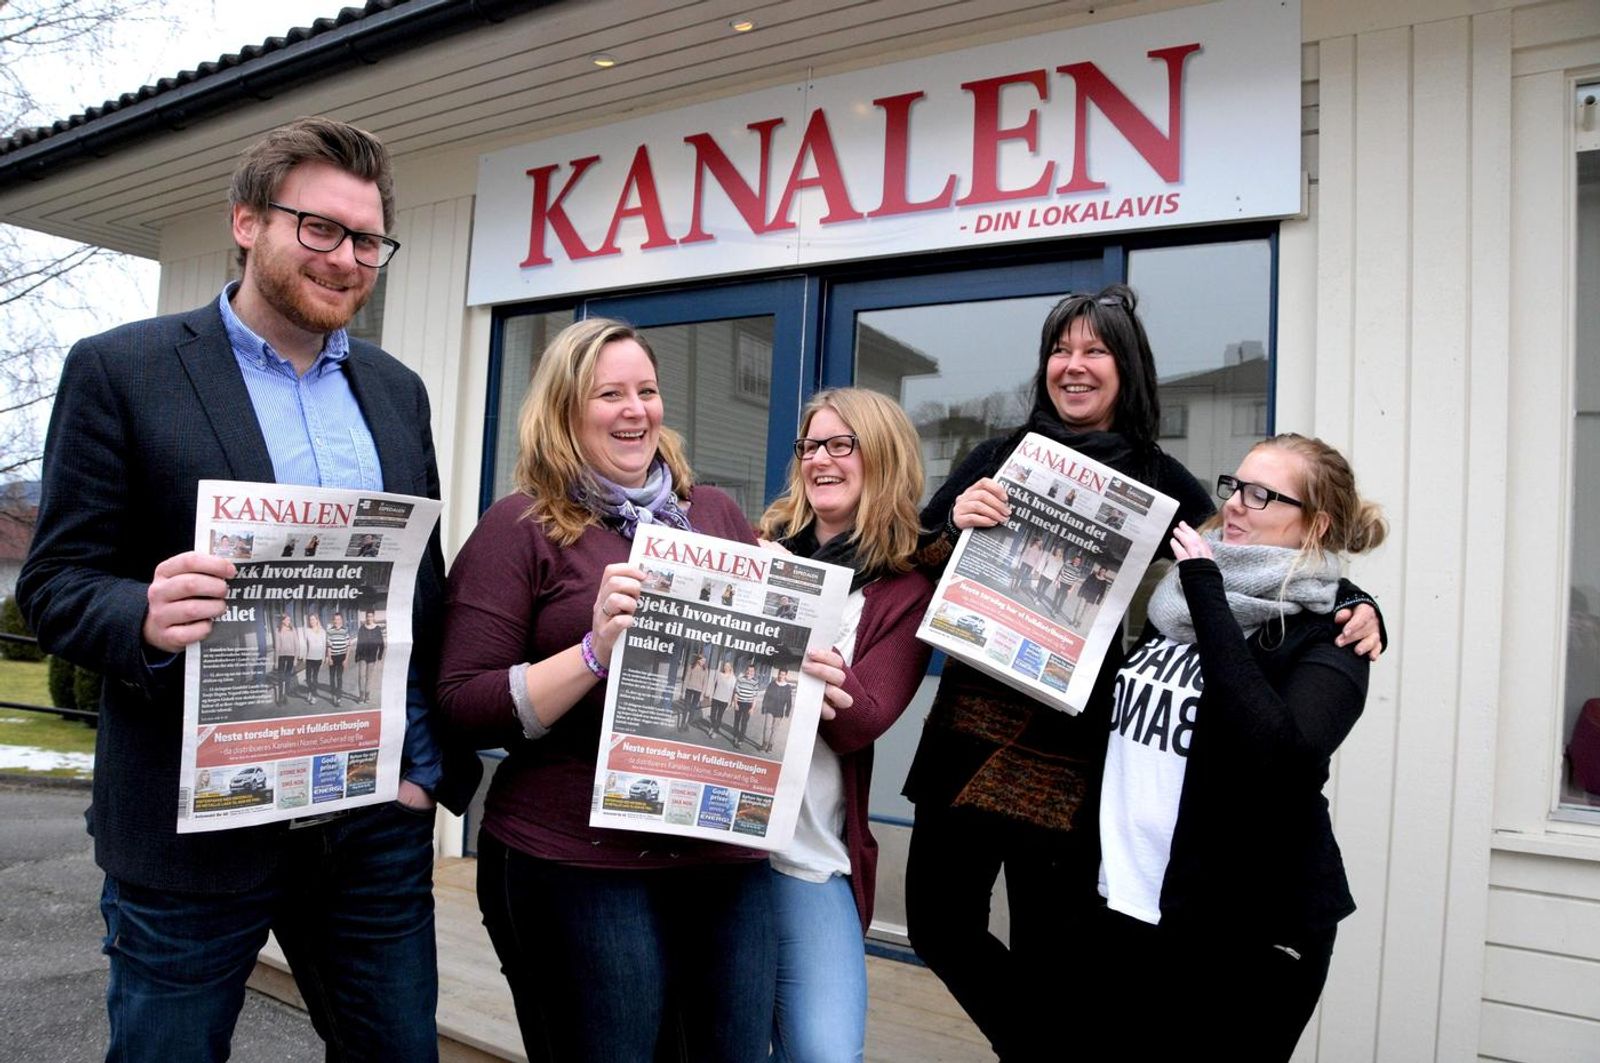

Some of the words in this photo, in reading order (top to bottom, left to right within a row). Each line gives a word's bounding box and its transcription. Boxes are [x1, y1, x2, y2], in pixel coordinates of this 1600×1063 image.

[519, 42, 1203, 269] KANALEN
[975, 209, 1020, 234] DIN
[1027, 193, 1180, 229] LOKALAVIS
[1017, 440, 1109, 493] KANALEN
[211, 495, 354, 525] KANALEN
[1015, 505, 1031, 520] til
[1030, 514, 1060, 534] med
[1059, 526, 1104, 554] Lunde-
[1031, 496, 1084, 531] hvordan
[1085, 525, 1107, 541] det
[262, 564, 335, 579] hvordan
[336, 565, 363, 578] det
[642, 536, 767, 582] KANALEN
[243, 584, 263, 599] til
[265, 585, 304, 599] med
[307, 585, 363, 599] Lunde-
[632, 616, 664, 632] står
[664, 621, 683, 637] til
[684, 627, 723, 646] med
[724, 635, 779, 657] Lunde-
[636, 596, 681, 617] Sjekk
[681, 604, 751, 632] hvordan
[754, 619, 780, 639] det
[628, 635, 675, 655] målet
[214, 730, 243, 743] Neste
[244, 727, 280, 741] torsdag
[280, 727, 295, 737] har
[297, 726, 306, 735] vi
[306, 719, 370, 733] fulldistribusjon
[272, 740, 296, 750] Kanalen
[623, 742, 645, 753] Neste
[645, 745, 676, 760] torsdag
[676, 750, 691, 760] har
[692, 752, 700, 761] vi
[701, 754, 768, 776] fulldistribusjon
